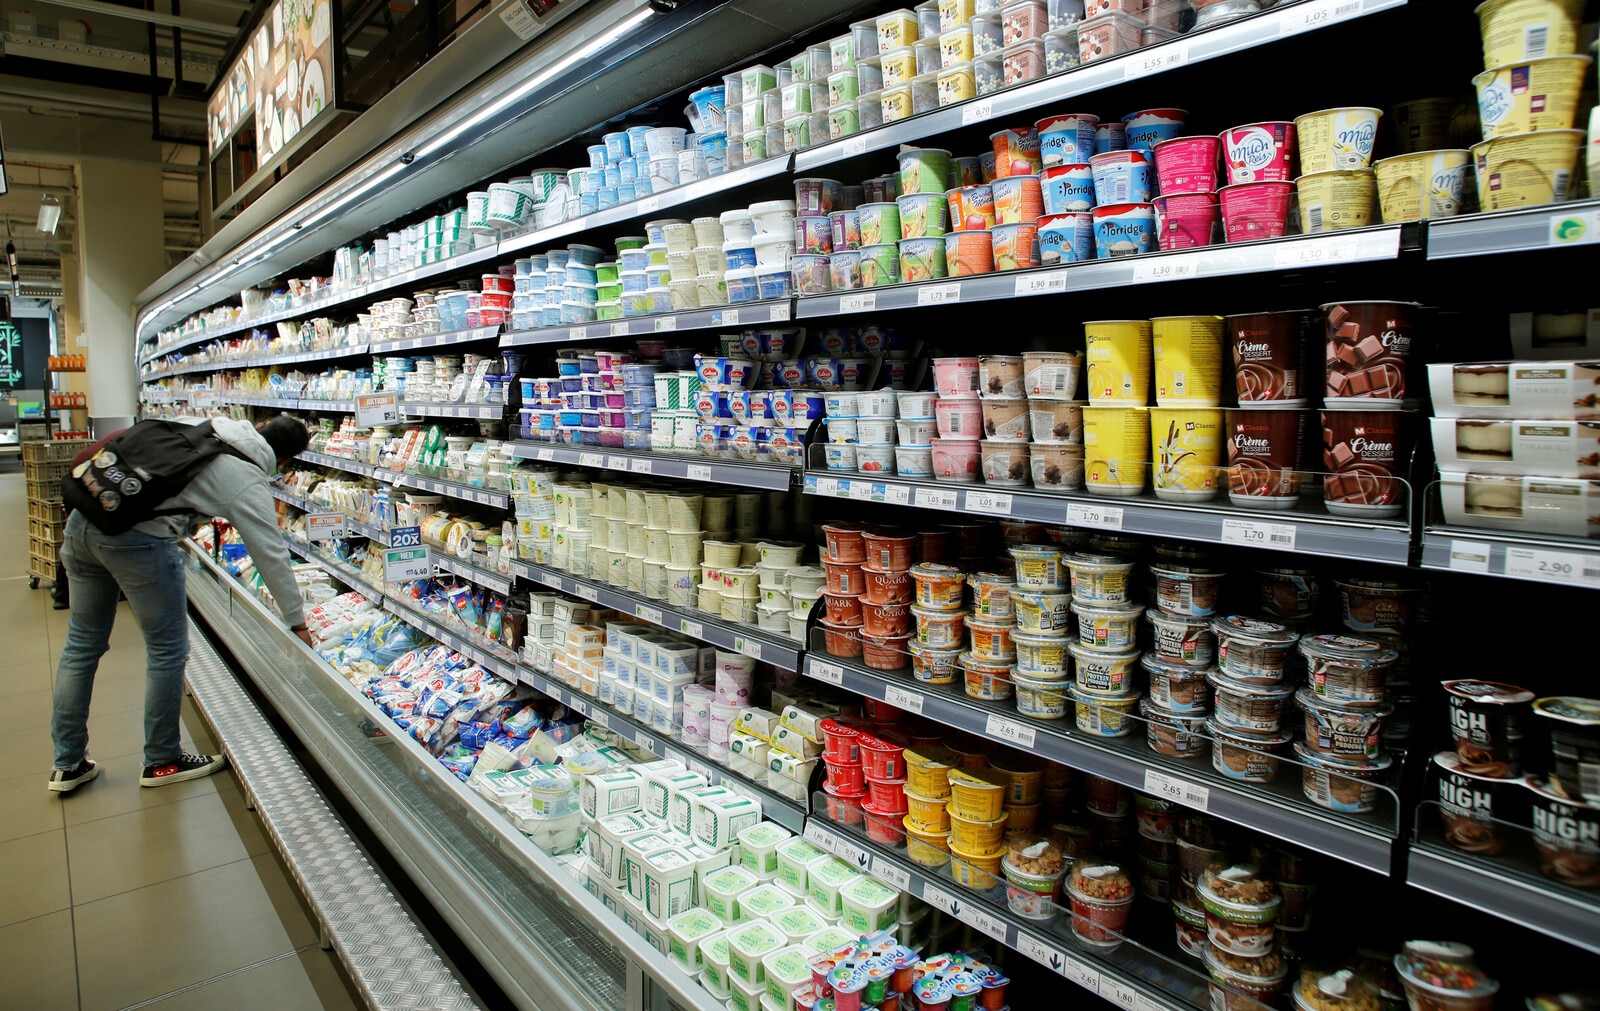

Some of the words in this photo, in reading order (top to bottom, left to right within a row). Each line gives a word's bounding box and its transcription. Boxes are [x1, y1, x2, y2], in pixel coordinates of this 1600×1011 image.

[1304, 9, 1328, 24] 1.05
[1144, 58, 1162, 70] 1.55
[976, 107, 990, 116] 0.70
[1041, 136, 1066, 151] orridge
[1231, 139, 1269, 161] Milch
[1248, 152, 1267, 165] Reis
[1107, 222, 1144, 236] Porridge
[1298, 248, 1322, 262] 1.30
[1152, 264, 1171, 277] 1.30
[1030, 280, 1045, 288] 1.90
[1237, 341, 1269, 356] Crème
[1234, 434, 1268, 448] Crème
[1350, 438, 1392, 453] Crème
[1083, 512, 1099, 521] 1.70
[1243, 529, 1264, 540] 1.70
[400, 552, 413, 560] NEU
[1538, 561, 1572, 574] 2.90
[1160, 638, 1182, 647] PROTEIN
[1087, 664, 1110, 674] Chiefs
[1087, 672, 1110, 680] PROTEIN
[896, 695, 907, 705] 2.65
[1450, 706, 1486, 730] IGH
[1000, 725, 1015, 735] 2.65
[1334, 734, 1364, 743] PROTEIN
[1335, 741, 1362, 749] PUDDING
[1162, 784, 1181, 796] 2.65
[1439, 778, 1492, 809] HIGH
[1532, 805, 1600, 841] HIGH
[813, 831, 823, 840] 1.80
[882, 868, 894, 878] 1.80
[935, 894, 948, 906] 2.45
[974, 916, 988, 927] 1.80
[1030, 946, 1046, 958] 2.45
[880, 950, 904, 968] Petit
[846, 958, 876, 987] Suisse
[967, 968, 997, 983] Petit
[931, 973, 965, 999] Suisse
[1080, 974, 1097, 987] 2.65
[1116, 990, 1133, 1003] 1.80
